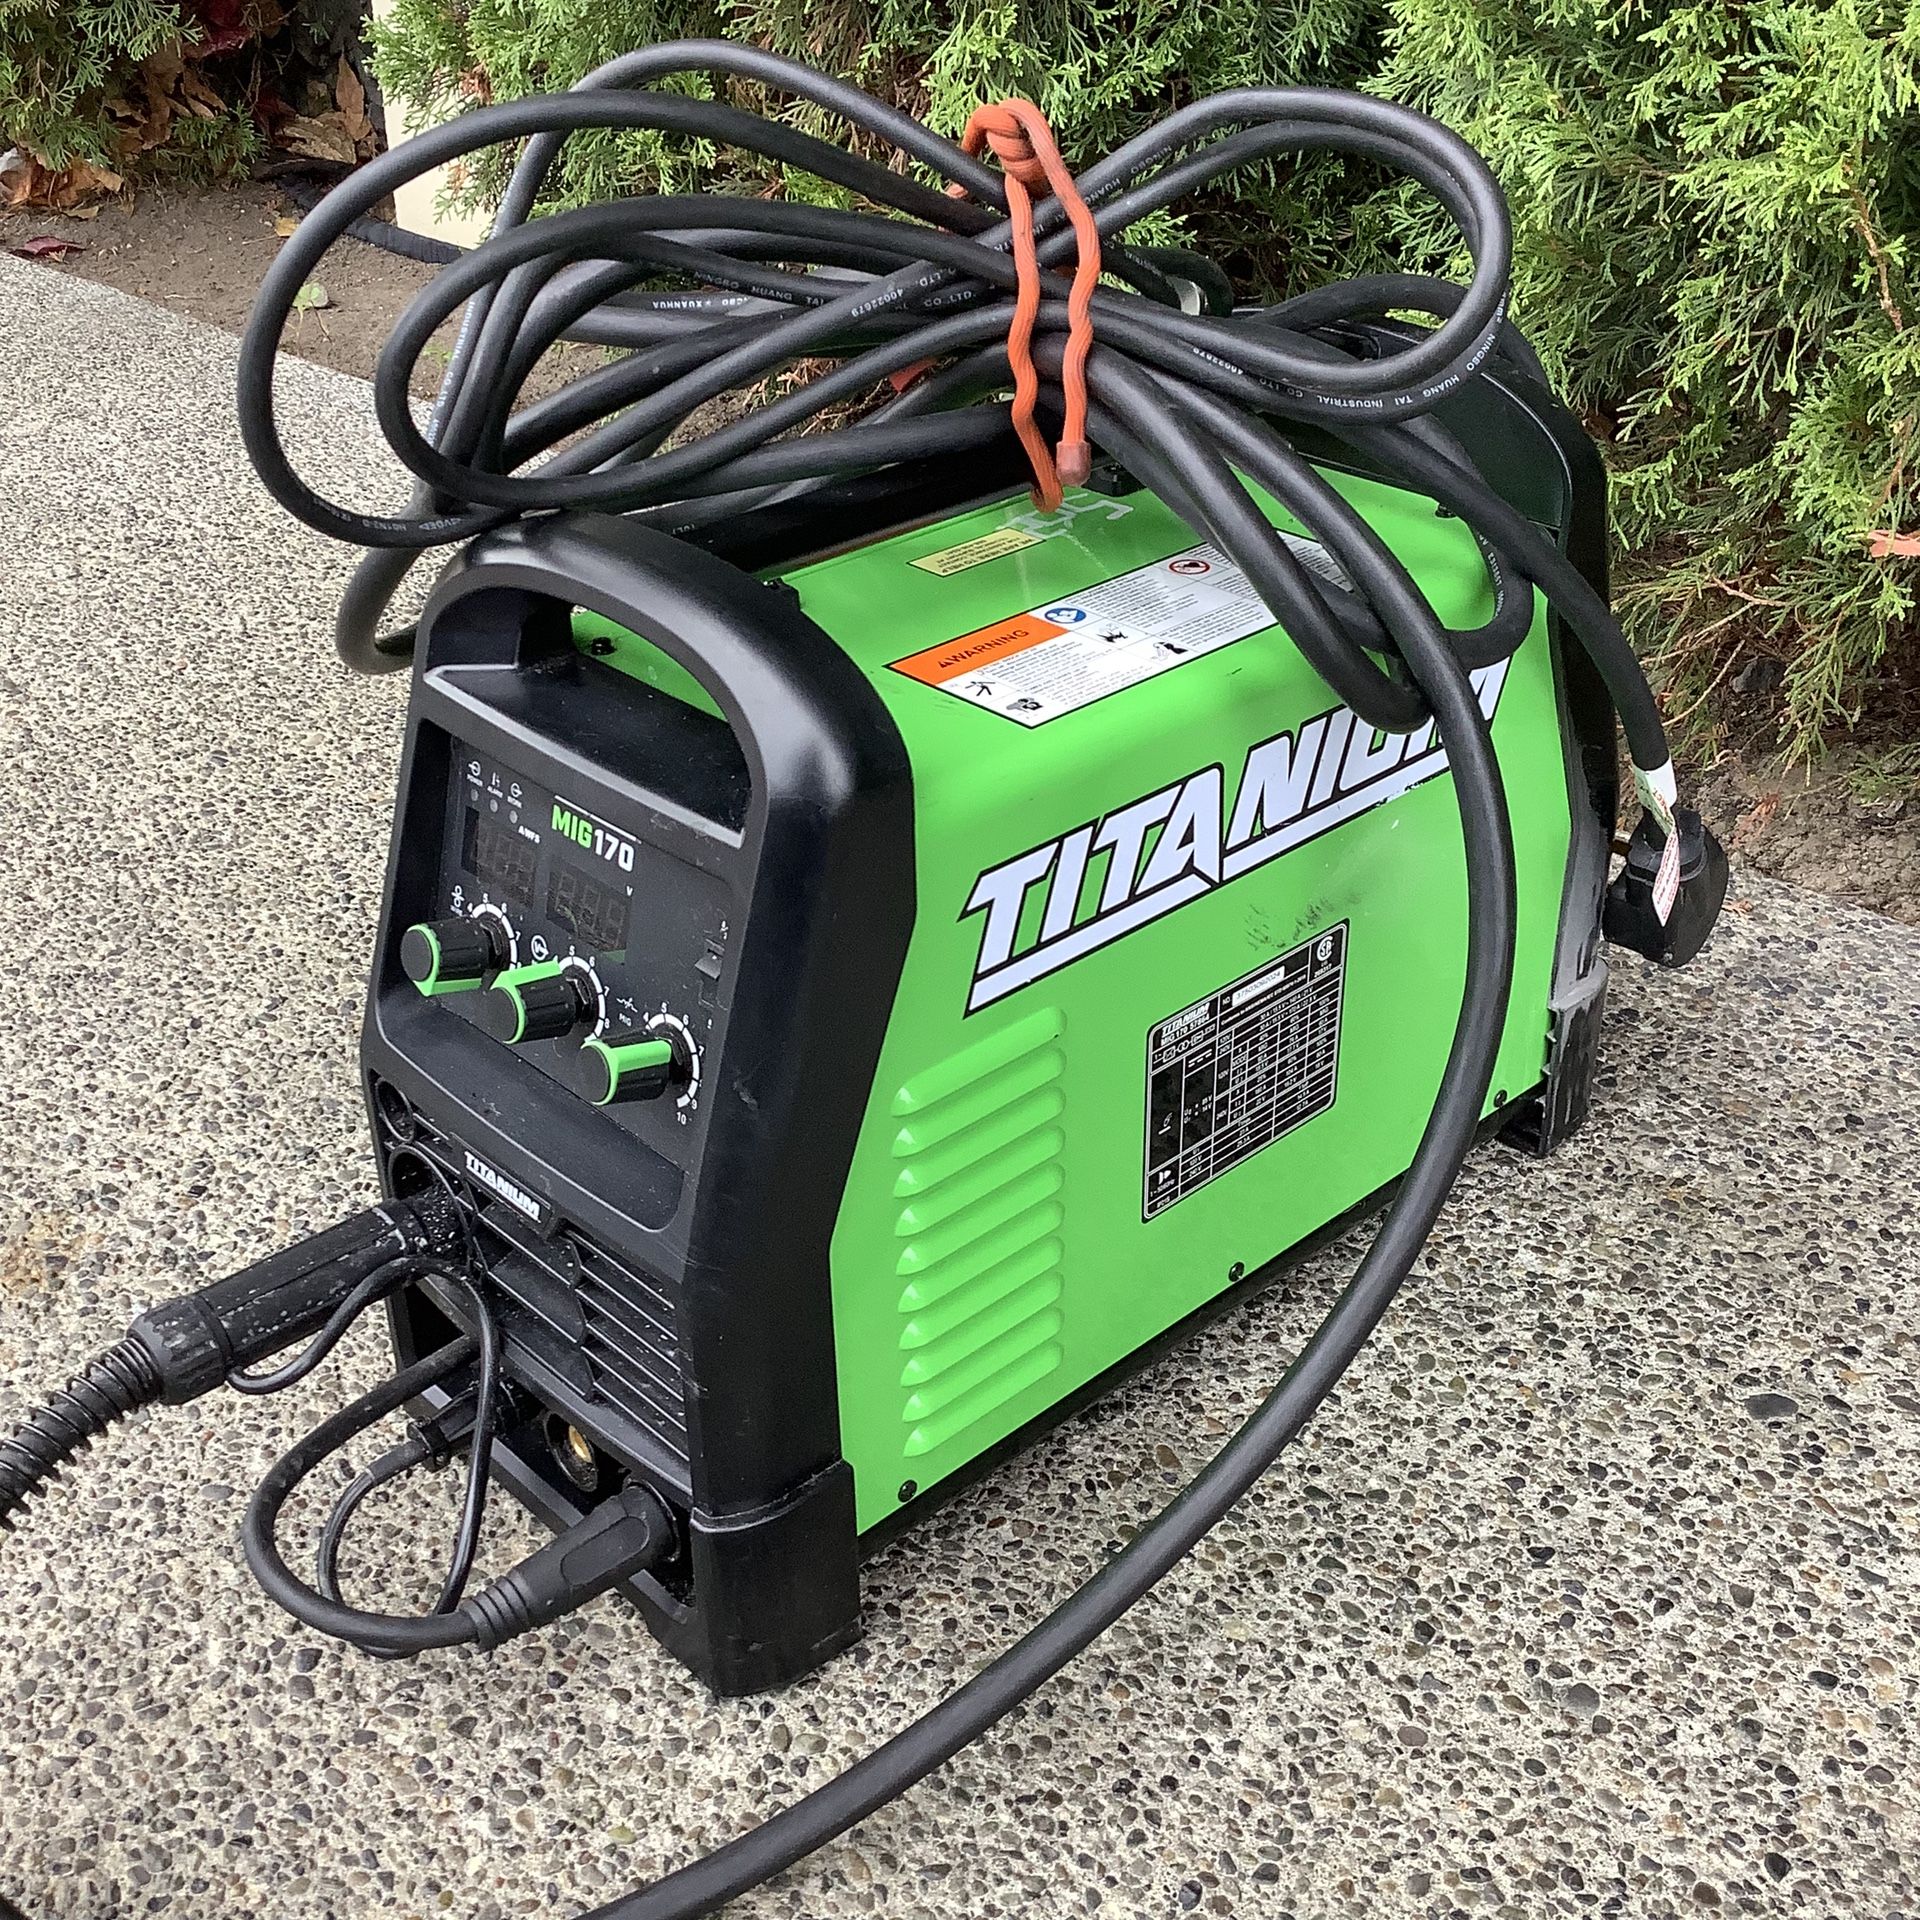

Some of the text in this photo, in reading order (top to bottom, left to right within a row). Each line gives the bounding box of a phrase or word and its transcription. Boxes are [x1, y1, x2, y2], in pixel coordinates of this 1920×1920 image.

[751, 286, 793, 301] HUANG
[652, 299, 702, 310] XUANHUA
[1466, 333, 1496, 371] NINGBO
[1422, 374, 1460, 398] HUANG
[1317, 393, 1384, 408] INDUSTRIAL
[1394, 395, 1413, 406] TAI
[946, 629, 1030, 663] WARNING
[482, 893, 489, 904] 5
[501, 902, 508, 914] 6
[514, 931, 521, 942] 7
[569, 944, 576, 957] 5
[589, 955, 596, 968] 6
[603, 985, 610, 997] 7
[660, 1001, 668, 1014] 5
[604, 1017, 611, 1030] 8
[682, 1013, 690, 1027] 6
[1161, 1001, 1211, 1038] TITANIUM
[697, 1045, 705, 1057] 7
[691, 1098, 698, 1110] 9
[676, 1111, 687, 1126] 10
[464, 1151, 541, 1223] TITANIUM
